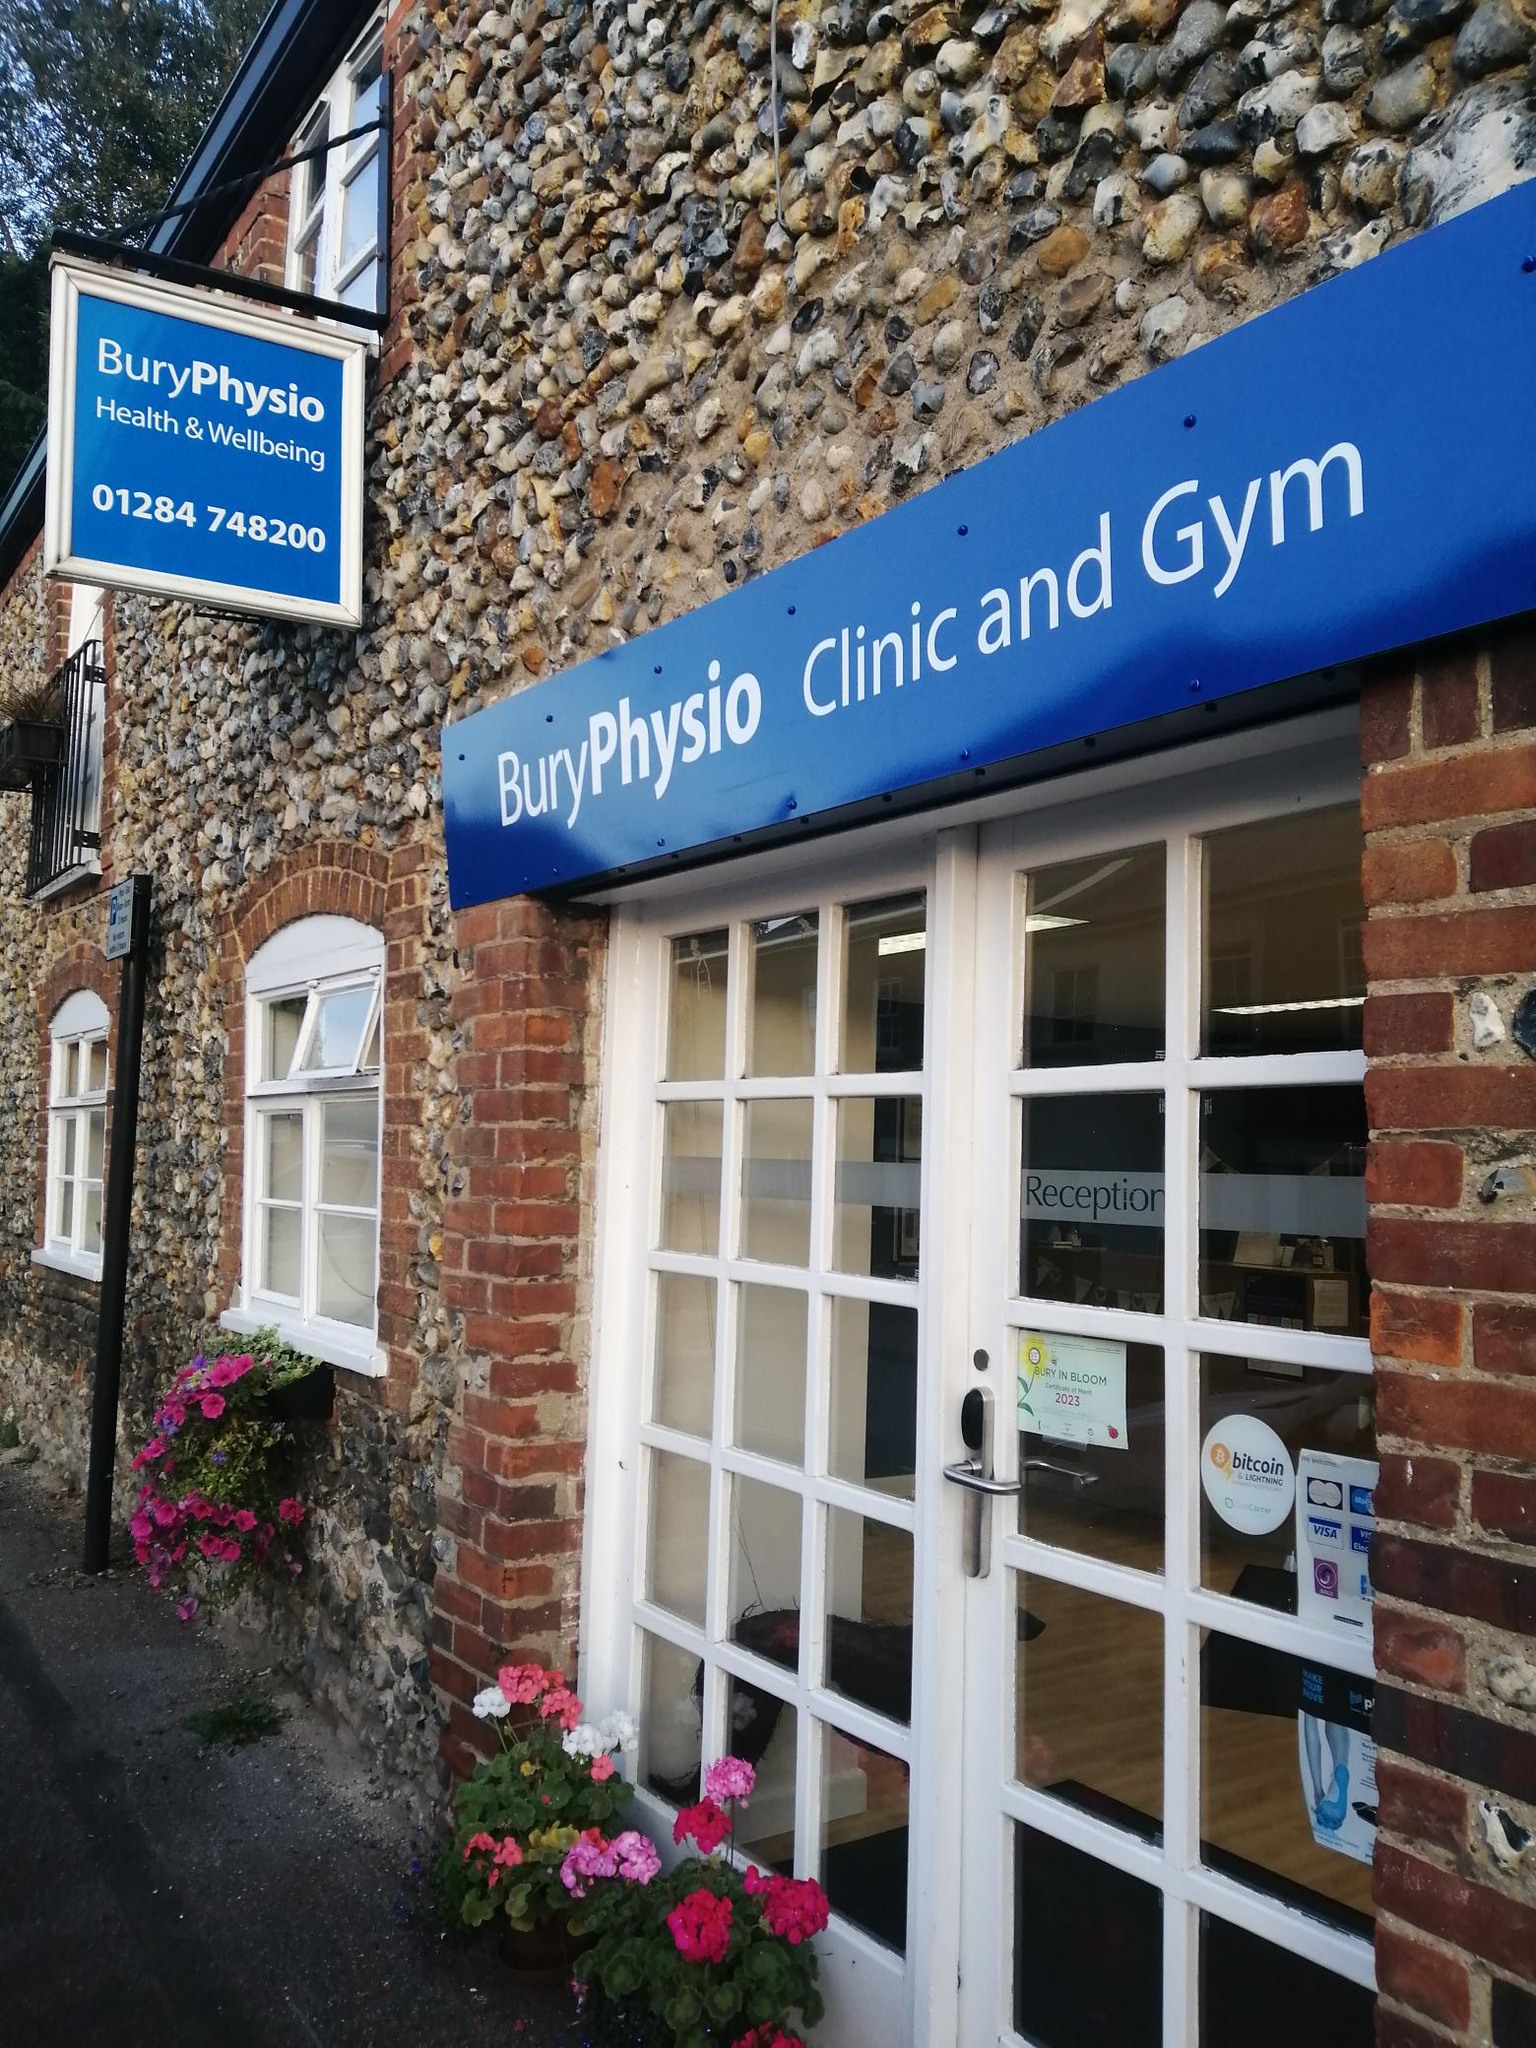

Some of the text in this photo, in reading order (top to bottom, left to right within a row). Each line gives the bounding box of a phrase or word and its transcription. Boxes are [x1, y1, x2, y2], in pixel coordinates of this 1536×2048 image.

[97, 338, 325, 423] BuryPhysio
[96, 395, 326, 472] Health & Wellbeing
[92, 484, 326, 553] 01284 748200
[497, 442, 1364, 829] BuryPhysio Clinic and Gym
[1026, 1175, 1165, 1221] Reception
[1033, 1366, 1107, 1386] BURY IN BLOOM
[1055, 1392, 1080, 1407] 2023
[1232, 1451, 1285, 1476] bitcoin
[1245, 1473, 1283, 1487] LIGHTNING
[1313, 1524, 1338, 1540] VISA
